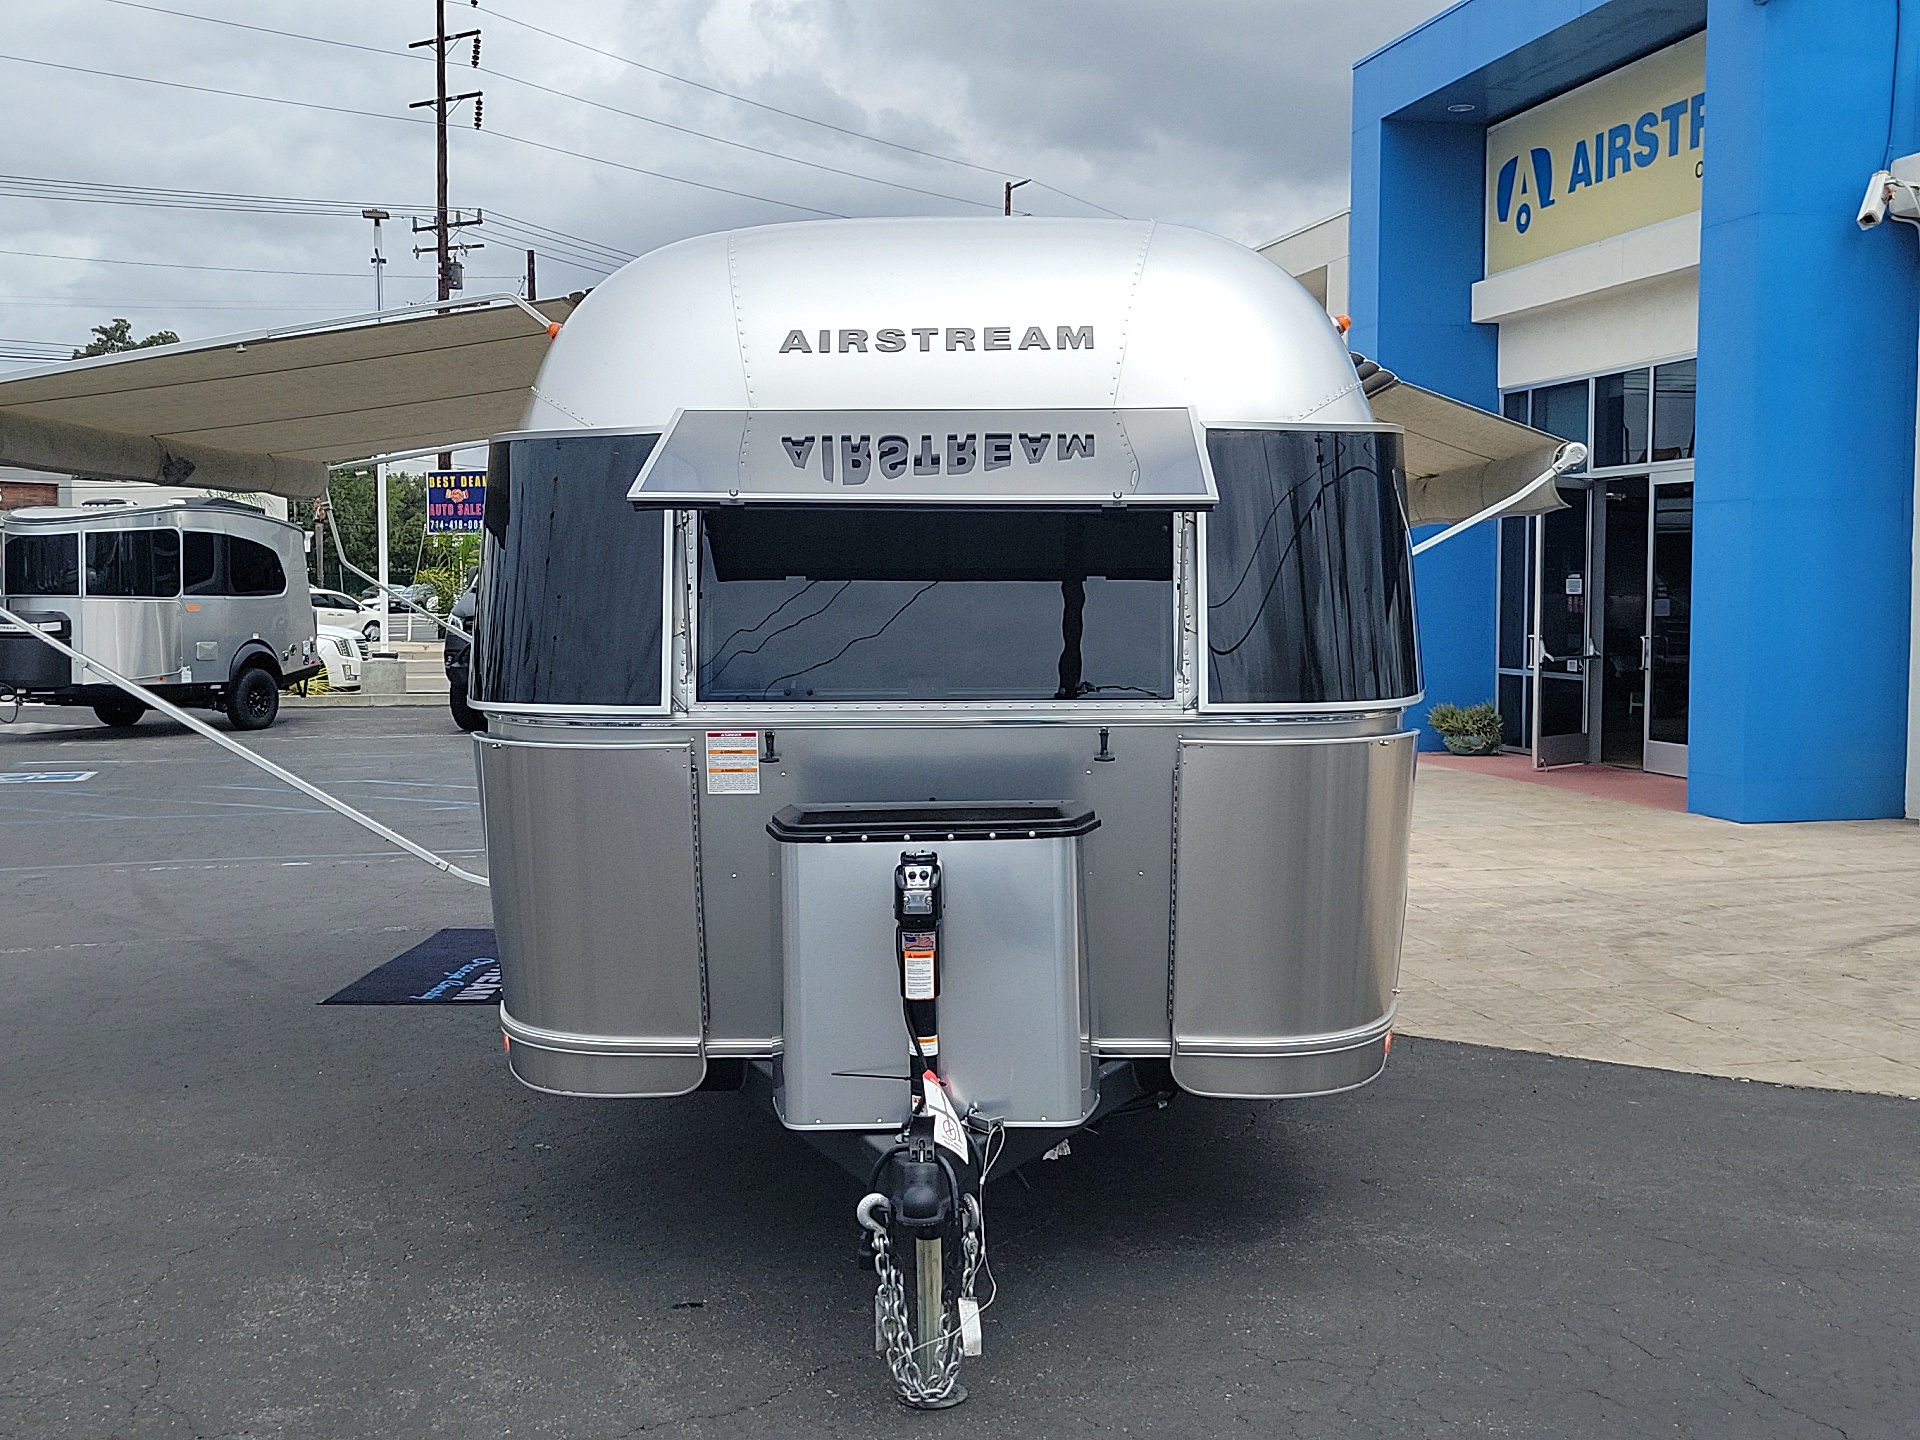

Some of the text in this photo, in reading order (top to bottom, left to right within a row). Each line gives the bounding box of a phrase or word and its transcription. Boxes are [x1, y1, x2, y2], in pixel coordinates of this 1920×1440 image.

[779, 326, 1094, 353] AIRSTREAM
[429, 477, 456, 488] BEST
[430, 504, 484, 516] AUTO SALE
